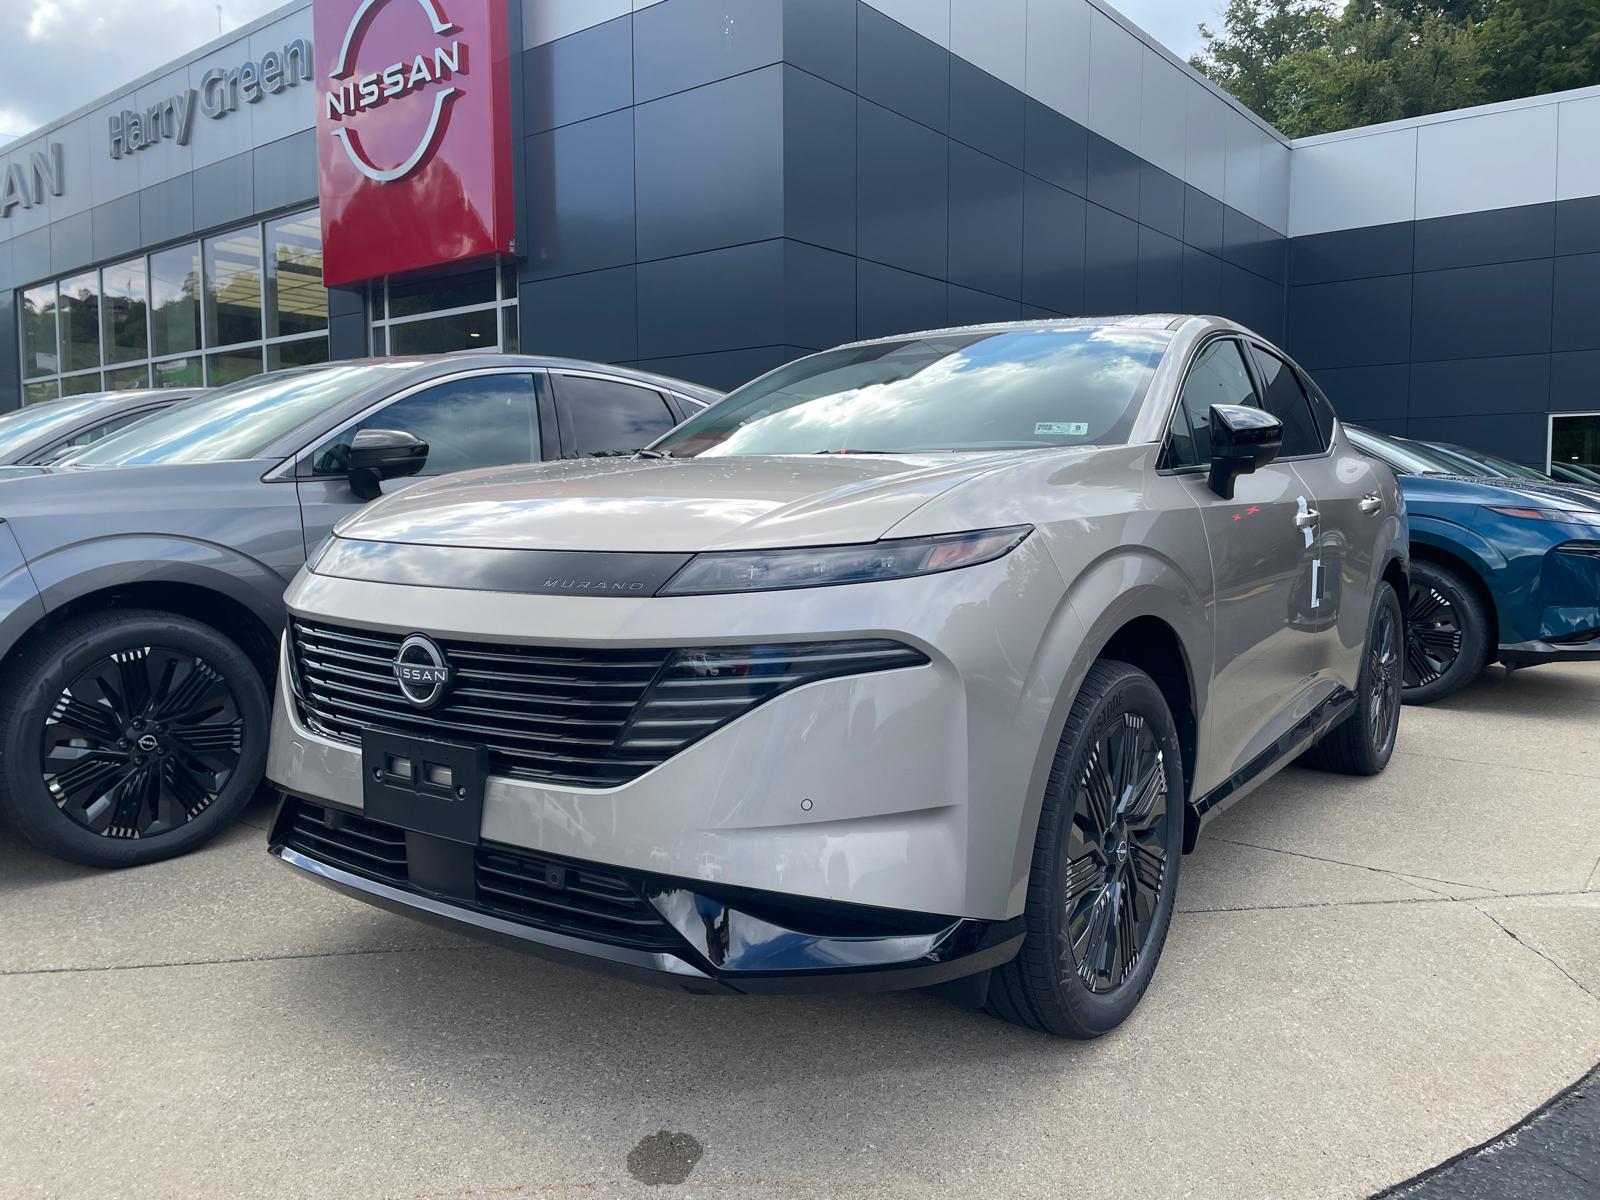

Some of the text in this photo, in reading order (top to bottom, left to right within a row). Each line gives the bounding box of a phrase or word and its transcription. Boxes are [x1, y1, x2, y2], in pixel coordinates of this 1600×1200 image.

[109, 38, 312, 158] Harry Green
[326, 41, 464, 119] NISSAN
[543, 579, 644, 590] MURANO
[393, 664, 446, 681] NISSAN
[1067, 689, 1124, 805] BRIDGESTONE
